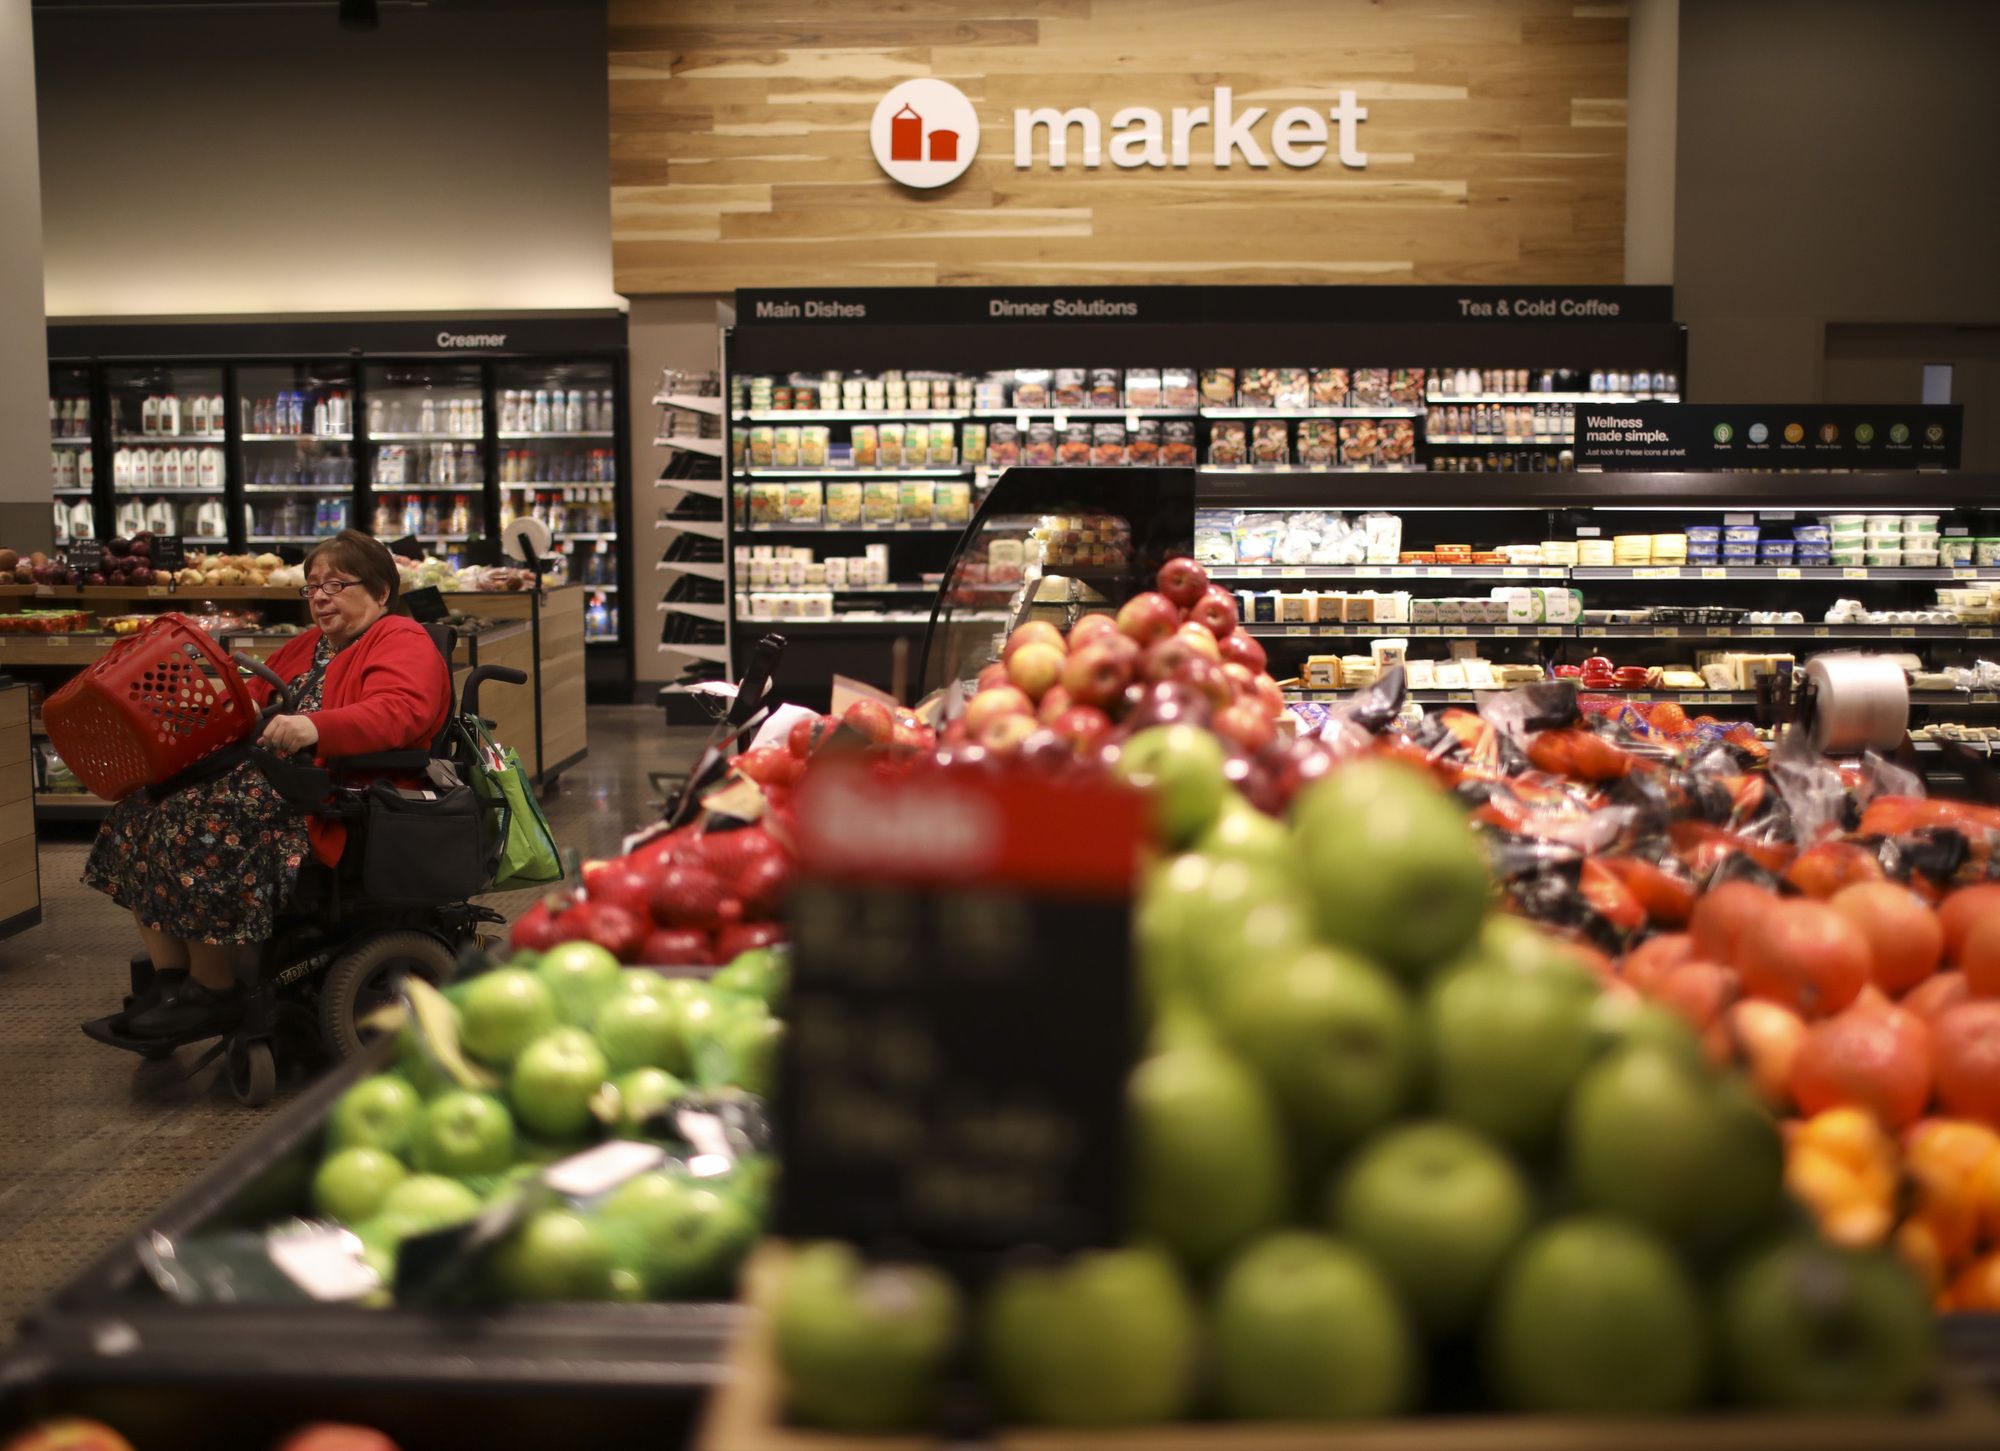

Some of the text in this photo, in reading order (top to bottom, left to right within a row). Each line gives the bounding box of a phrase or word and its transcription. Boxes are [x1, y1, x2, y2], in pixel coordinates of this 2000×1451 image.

[1014, 86, 1368, 168] market
[755, 301, 867, 318] Main Dishes
[989, 298, 1138, 317] Dinner Solutions
[1457, 299, 1620, 316] Tea & Cold Coffee
[437, 331, 508, 348] Creamer
[1587, 416, 1643, 428] Wellness
[1586, 430, 1669, 444] made simple.
[280, 960, 310, 985] TDX
